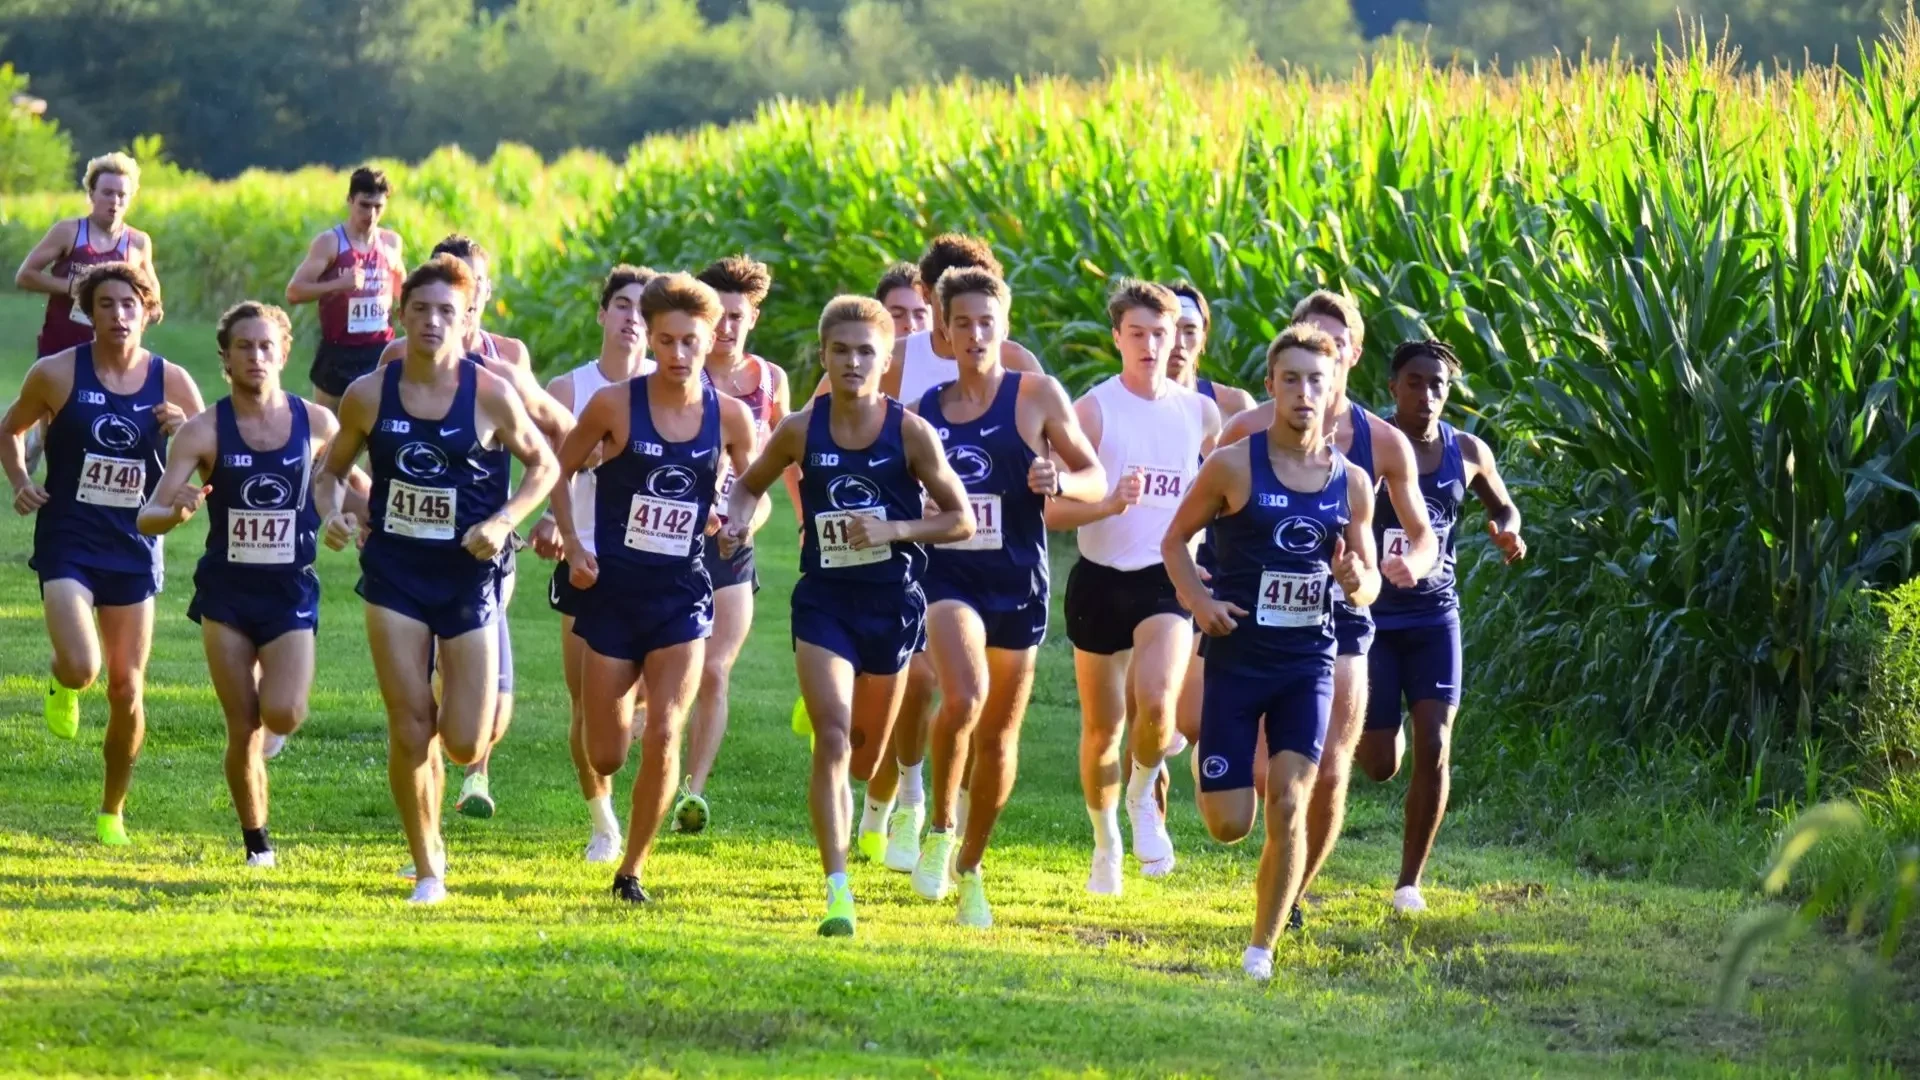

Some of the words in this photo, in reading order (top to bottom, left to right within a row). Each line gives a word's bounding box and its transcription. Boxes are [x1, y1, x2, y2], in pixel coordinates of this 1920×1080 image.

[86, 462, 141, 489] 4140
[1143, 473, 1180, 497] 134
[392, 490, 450, 518] 4145
[232, 517, 291, 541] 4147
[634, 504, 693, 534] 4142
[823, 520, 848, 545] 41
[1264, 579, 1322, 605] 4143
[1261, 603, 1287, 612] CROSS
